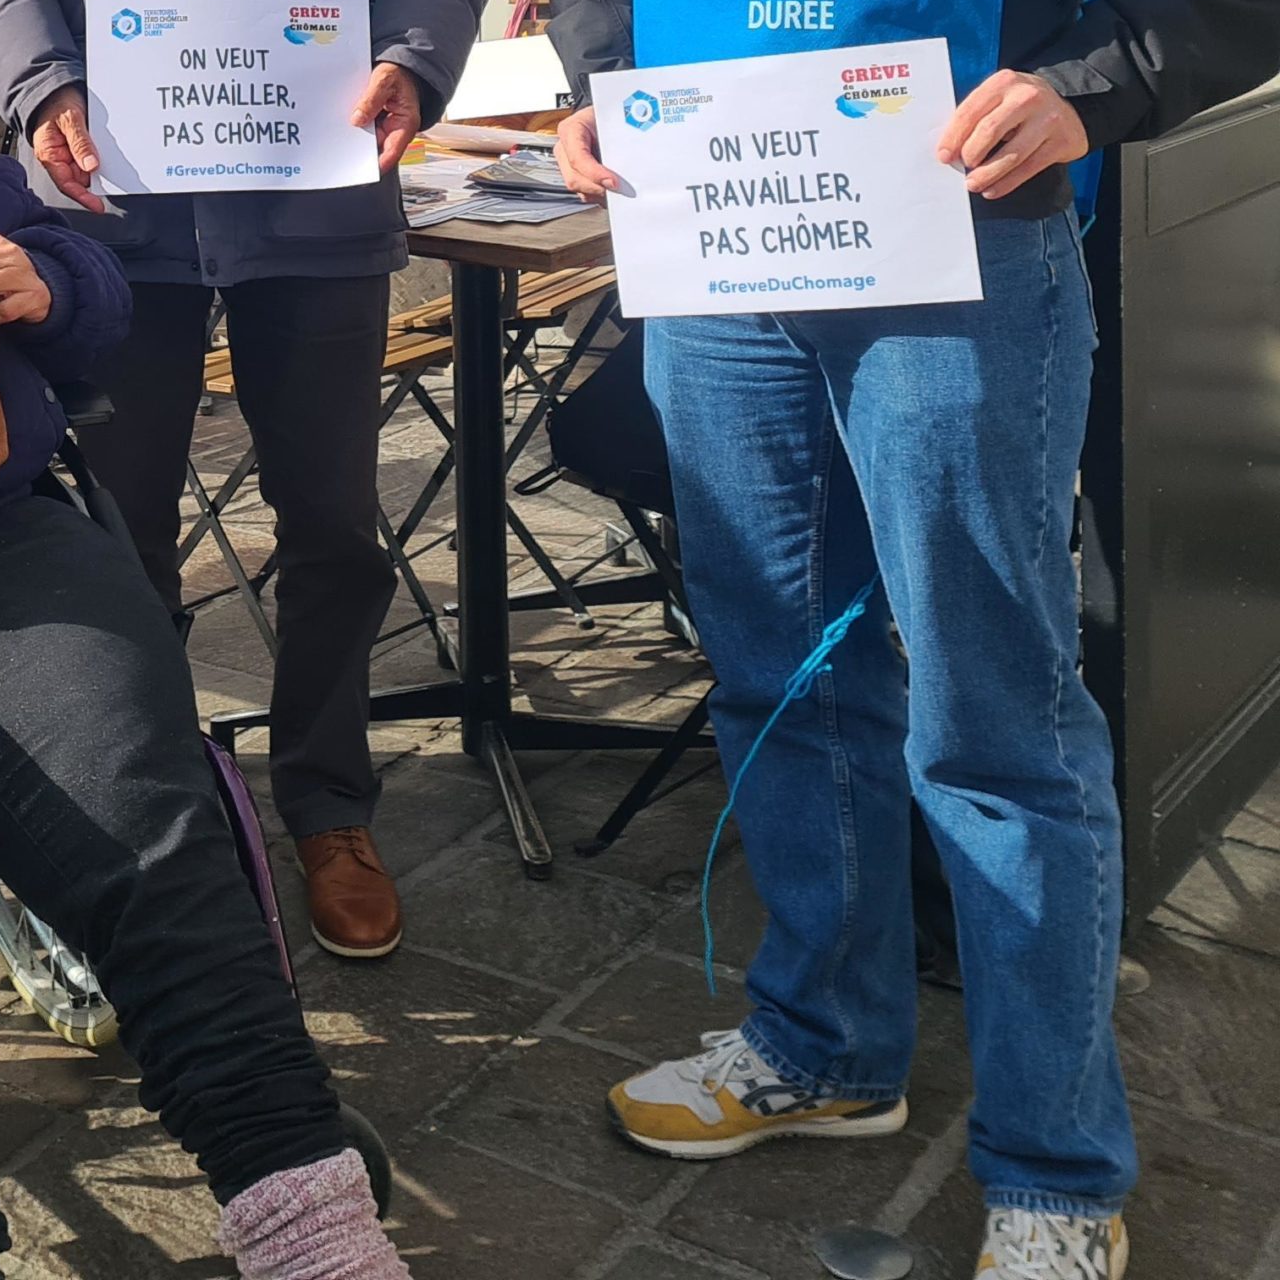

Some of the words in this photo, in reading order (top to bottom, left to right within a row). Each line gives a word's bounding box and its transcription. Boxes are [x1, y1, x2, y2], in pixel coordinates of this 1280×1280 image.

[289, 5, 340, 18] GRÈVE
[290, 23, 338, 31] CHÔMAGE
[180, 48, 207, 70] ON
[215, 47, 270, 72] VEUT
[841, 64, 910, 83] GRÈVE
[844, 86, 908, 100] CHÔMAGE
[163, 121, 204, 147] PAS
[214, 113, 301, 145] CHÔMER
[709, 135, 742, 162] ON
[751, 129, 820, 159] VEUT
[166, 164, 301, 177] #GreveDuChomage
[699, 227, 750, 258] PAS
[761, 213, 872, 253] CHÔMER
[708, 275, 877, 294] #GreveDuChomage
